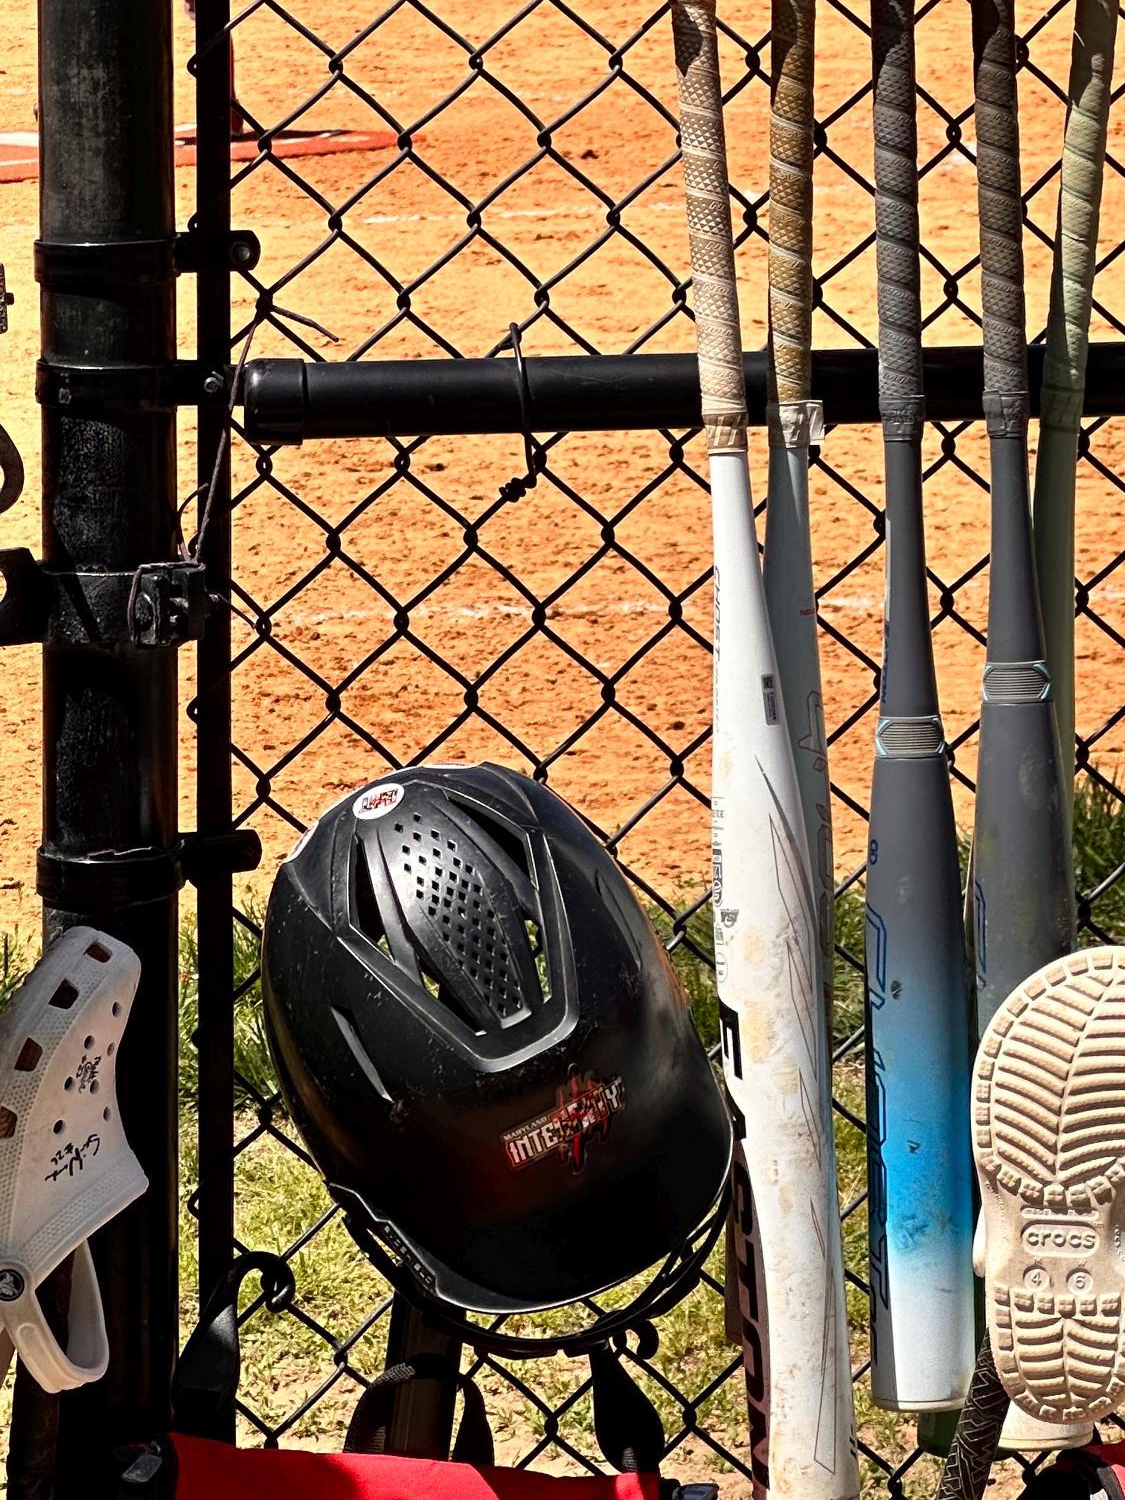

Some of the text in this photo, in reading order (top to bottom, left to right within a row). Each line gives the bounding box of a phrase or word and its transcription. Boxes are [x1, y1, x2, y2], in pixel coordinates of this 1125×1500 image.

[503, 1116, 549, 1141] MARYLAND
[1026, 1232, 1097, 1250] crocs
[1030, 1271, 1086, 1290] 4 6
